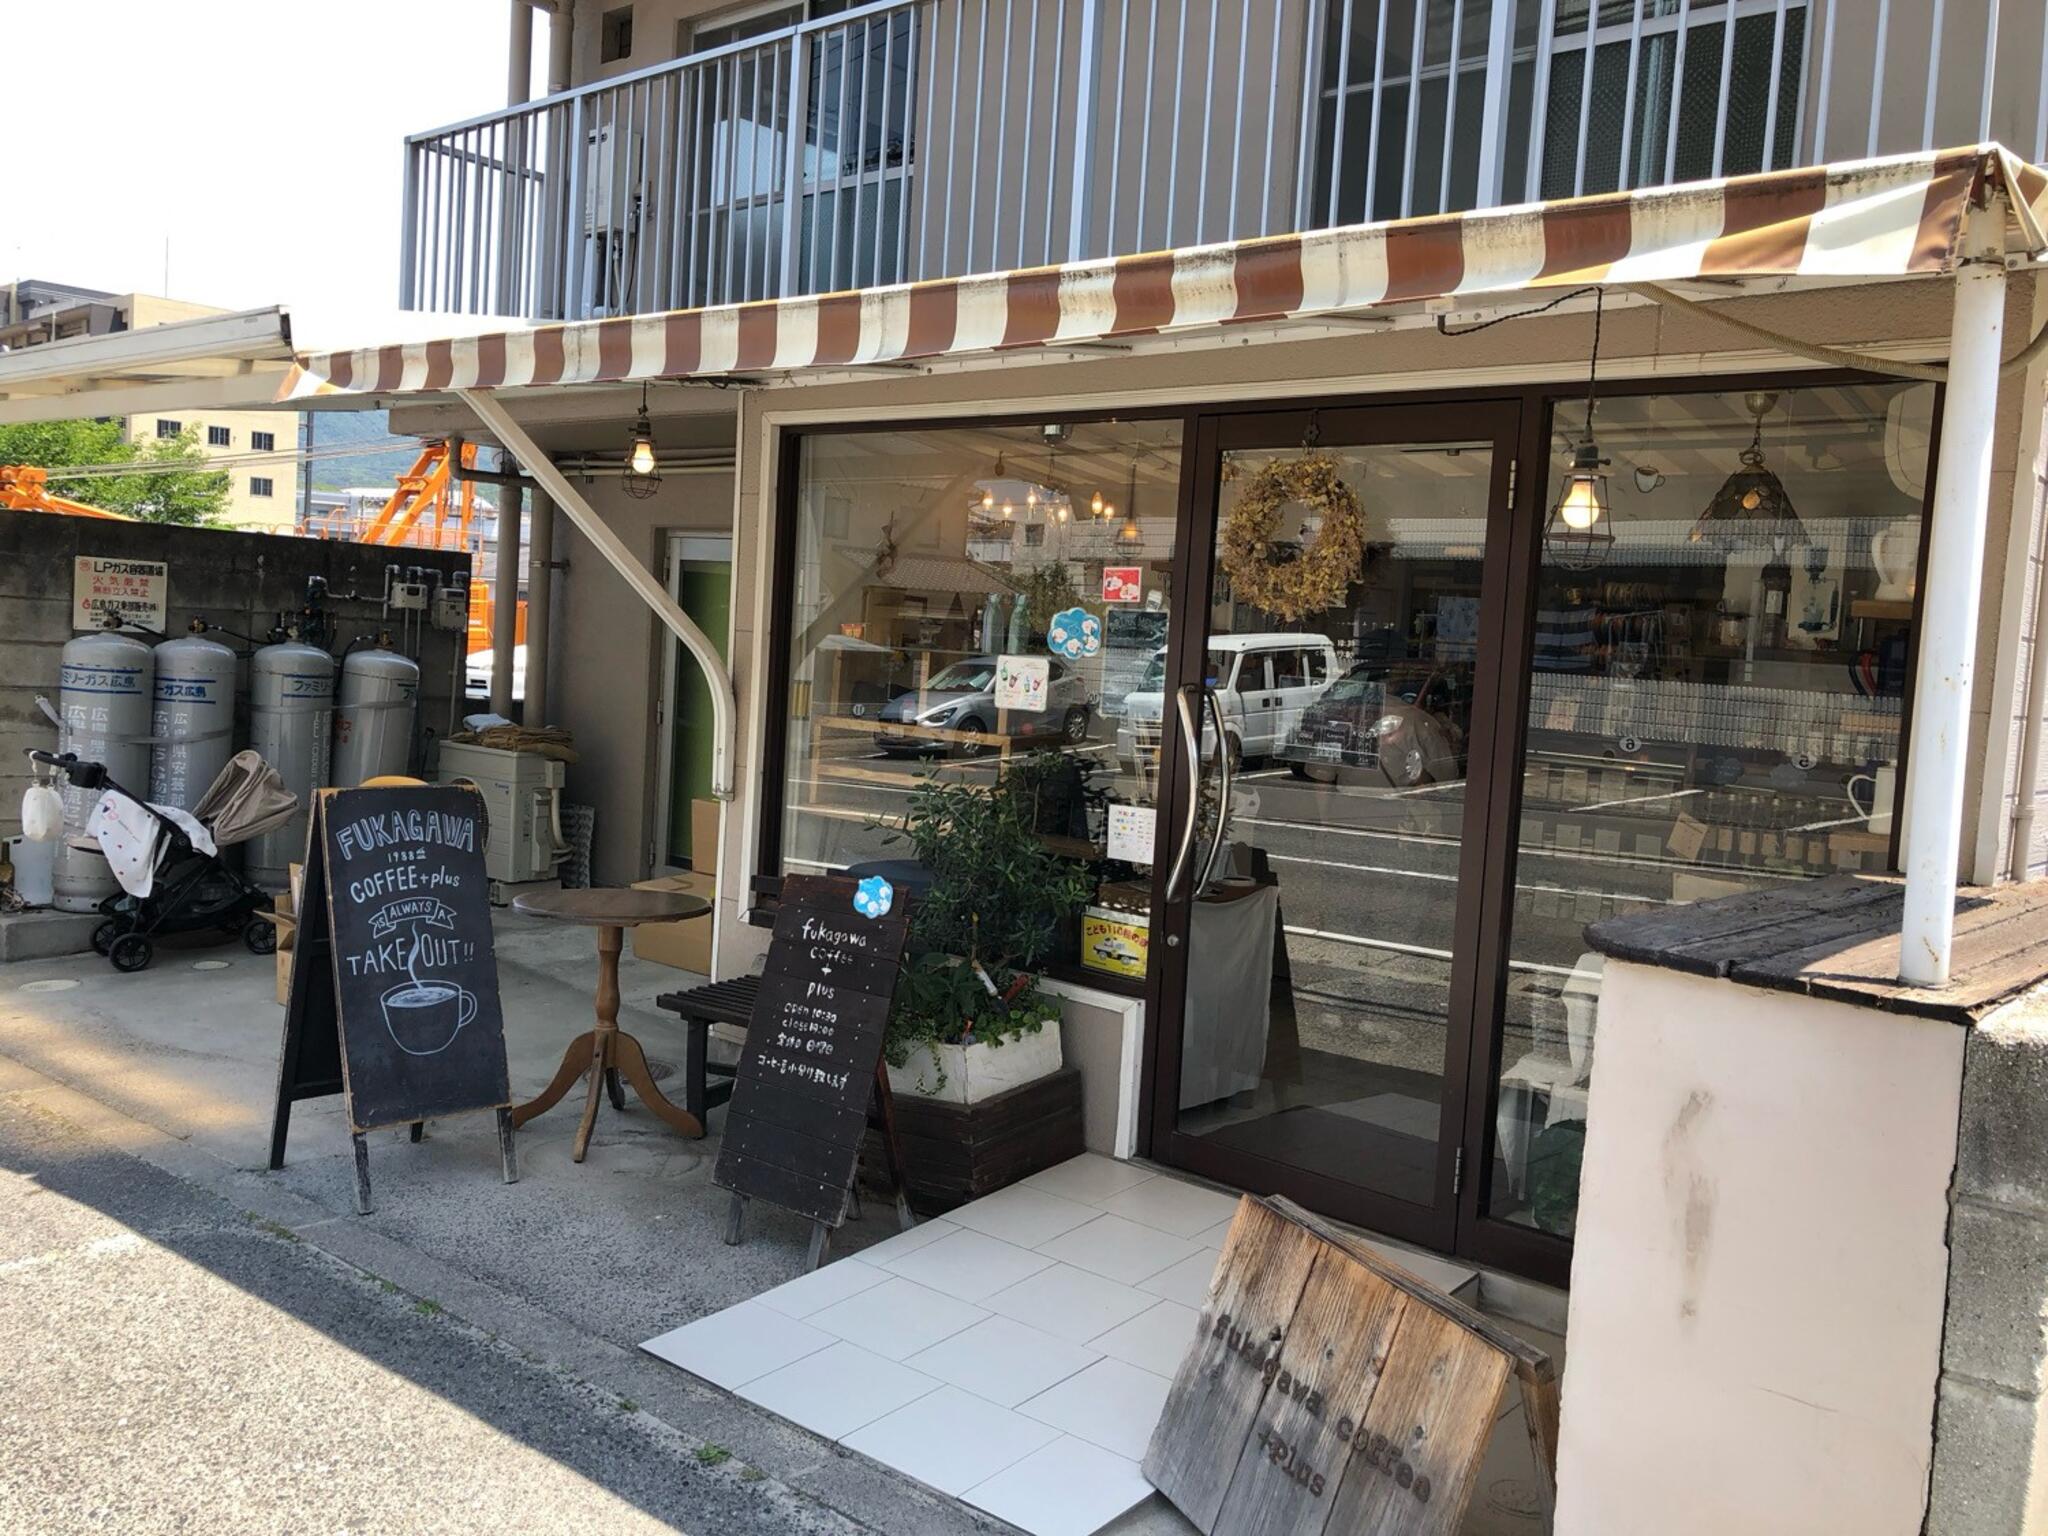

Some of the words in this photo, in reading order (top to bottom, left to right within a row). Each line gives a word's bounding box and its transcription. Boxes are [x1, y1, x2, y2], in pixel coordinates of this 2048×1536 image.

[335, 808, 475, 860] FUKAGAWA
[390, 901, 432, 918] ALWAYS
[437, 910, 447, 920] A
[346, 937, 407, 976] TAKE
[420, 933, 474, 967] OUT!!
[811, 1007, 838, 1023] 10:30
